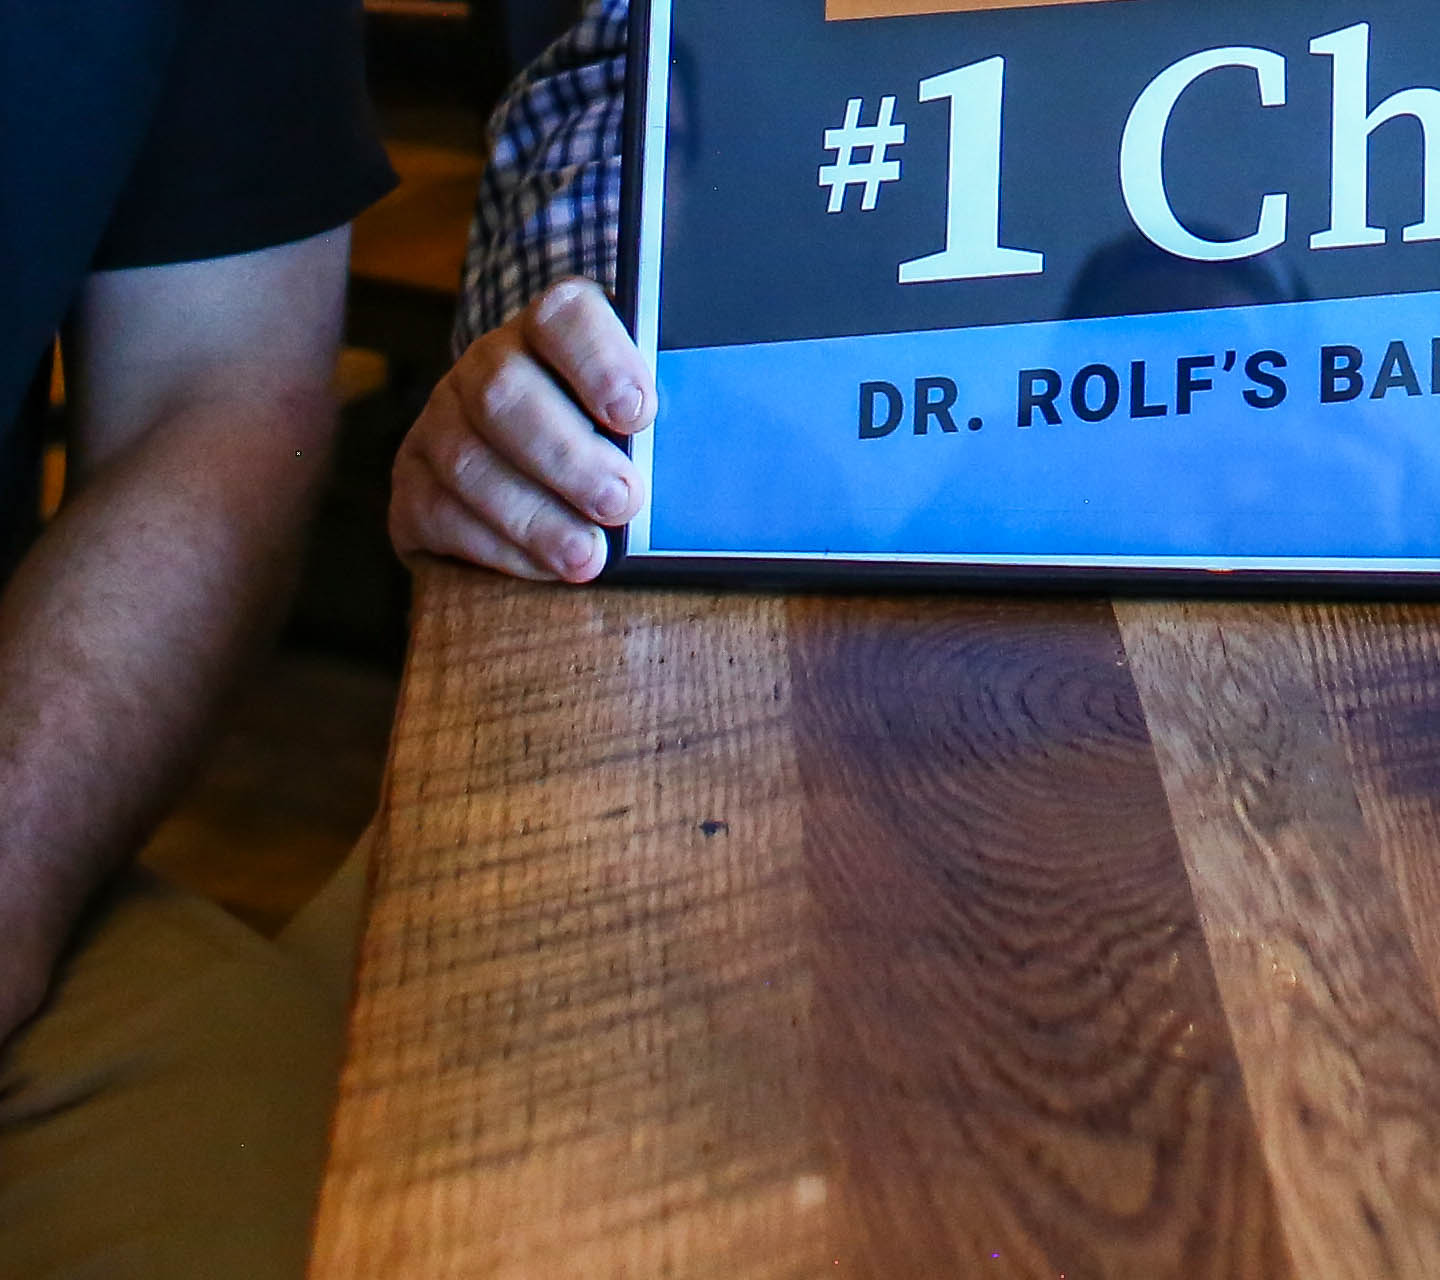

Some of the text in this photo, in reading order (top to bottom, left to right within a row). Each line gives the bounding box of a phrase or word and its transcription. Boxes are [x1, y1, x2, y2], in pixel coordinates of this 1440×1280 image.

[818, 55, 1045, 284] #1
[858, 381, 982, 439] DR.
[1017, 349, 1288, 427] ROLF'S
